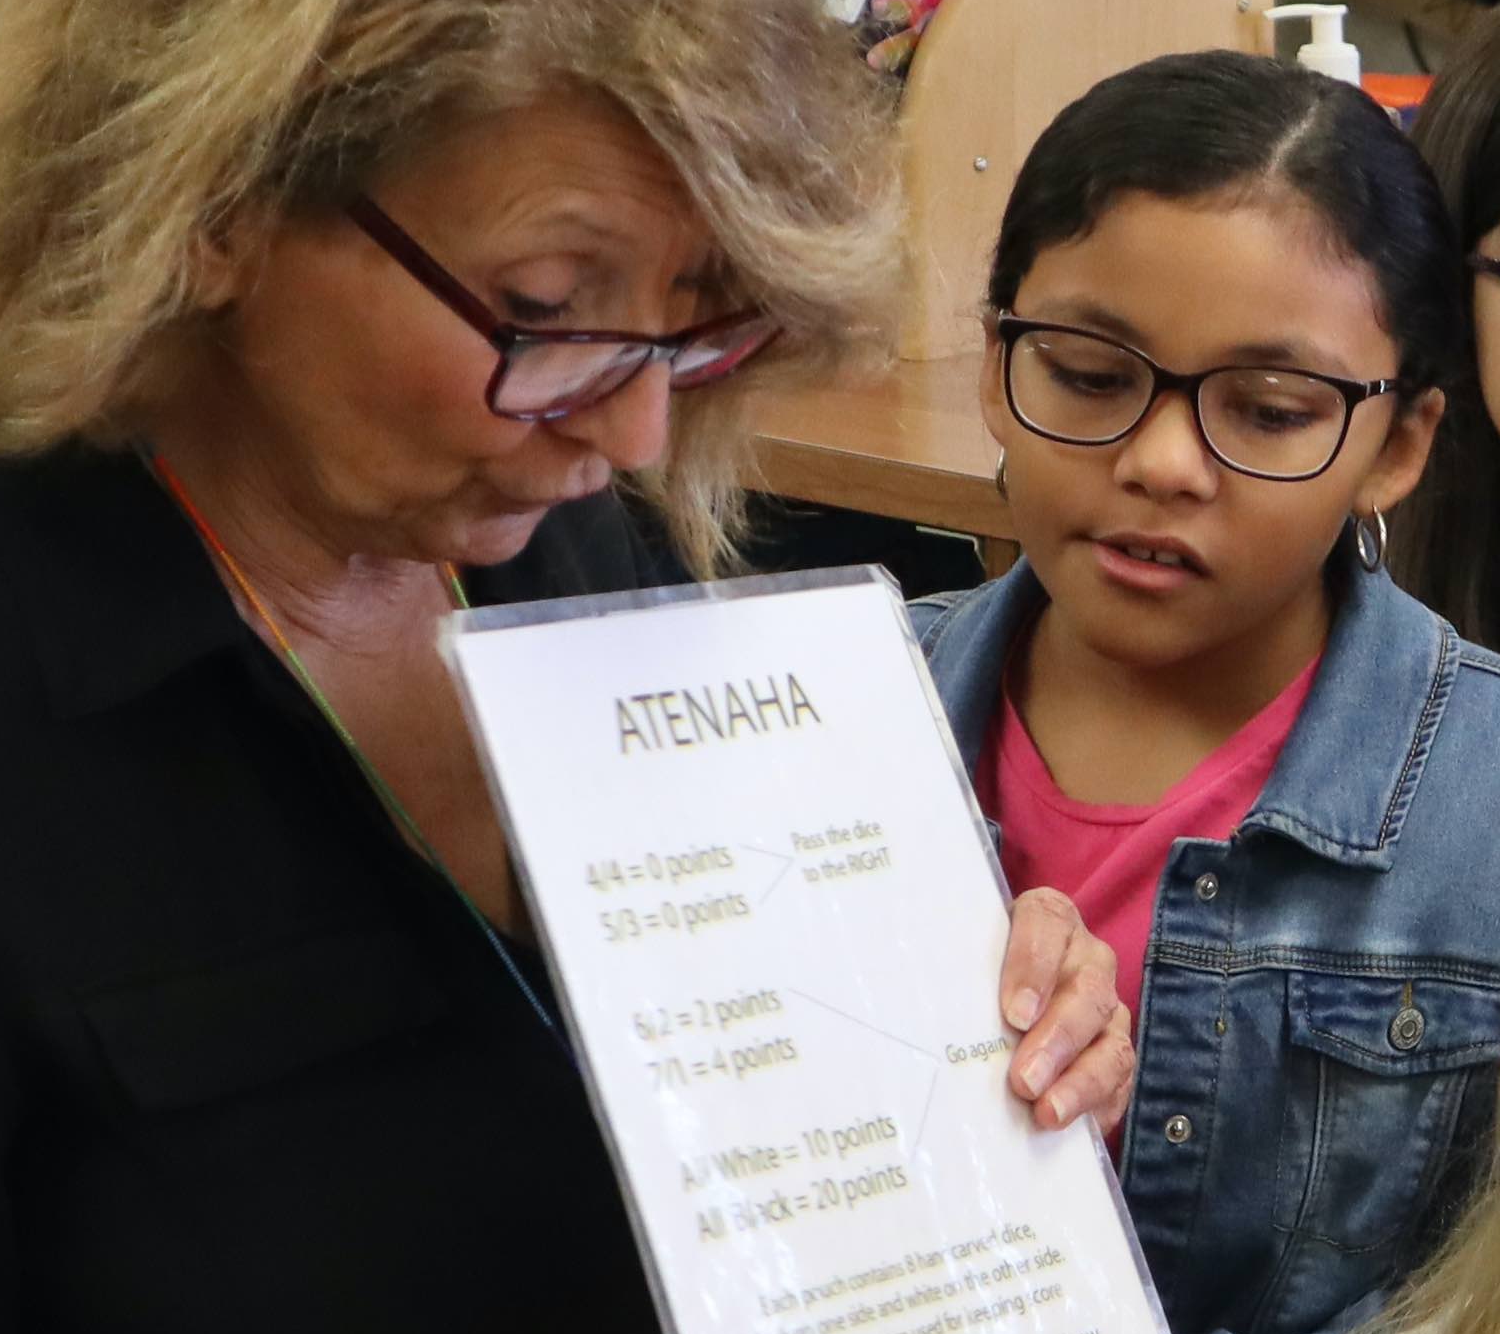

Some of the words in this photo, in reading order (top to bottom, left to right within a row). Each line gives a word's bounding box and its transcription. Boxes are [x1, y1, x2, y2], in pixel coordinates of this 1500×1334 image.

[615, 672, 822, 754] ATENAHA
[791, 831, 826, 852] Pass
[827, 825, 852, 845] the
[853, 819, 883, 840] dice
[586, 859, 625, 892] 4/4
[666, 845, 735, 884] points
[802, 865, 820, 883] to
[821, 859, 846, 879] the
[846, 846, 893, 875] RIGHT
[600, 907, 642, 943] 5/3
[681, 892, 750, 934] points
[695, 999, 712, 1028] 2
[715, 988, 783, 1031] points
[712, 1046, 730, 1077] 4
[731, 1037, 798, 1080] points
[945, 1044, 967, 1065] Go
[970, 1035, 1009, 1062] again
[711, 1145, 781, 1180] White
[802, 1128, 831, 1158] 10
[832, 1116, 898, 1159] points
[811, 1177, 841, 1210] 20
[842, 1164, 908, 1210] points
[1001, 1223, 1037, 1247] dice,
